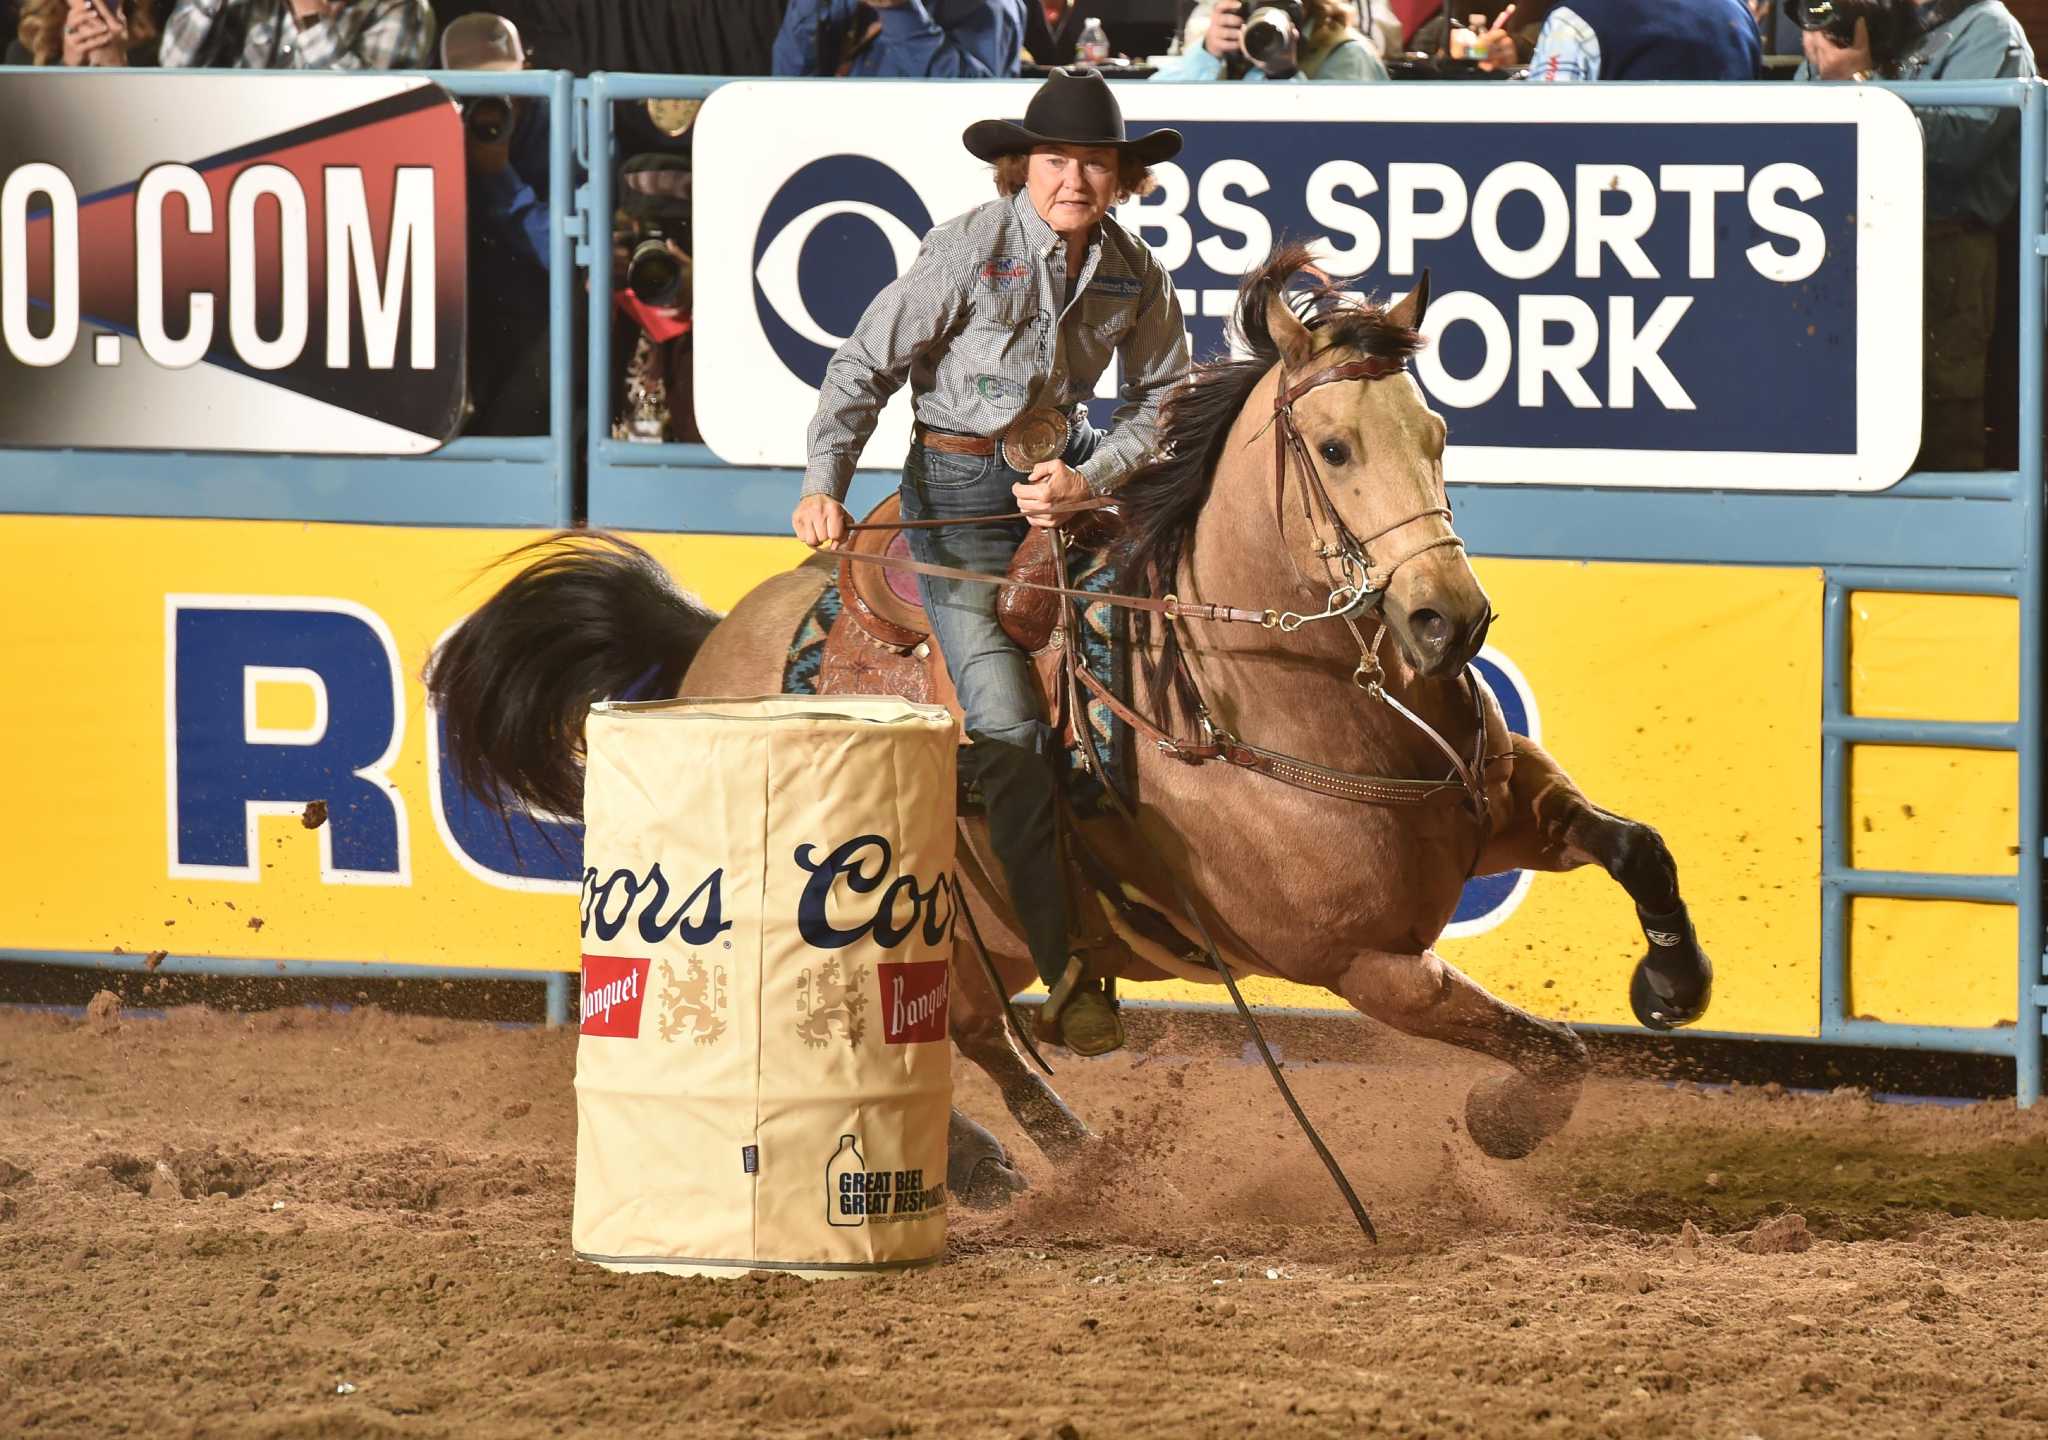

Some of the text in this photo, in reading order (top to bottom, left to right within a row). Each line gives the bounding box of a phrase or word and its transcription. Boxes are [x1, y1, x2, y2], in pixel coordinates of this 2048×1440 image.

[1, 162, 436, 370] O.COM
[1114, 158, 1827, 283] BS SPORTS
[580, 862, 733, 946] oors
[794, 834, 957, 949] Coo
[840, 1171, 891, 1193] GREAT
[840, 1193, 891, 1215] GREAT
